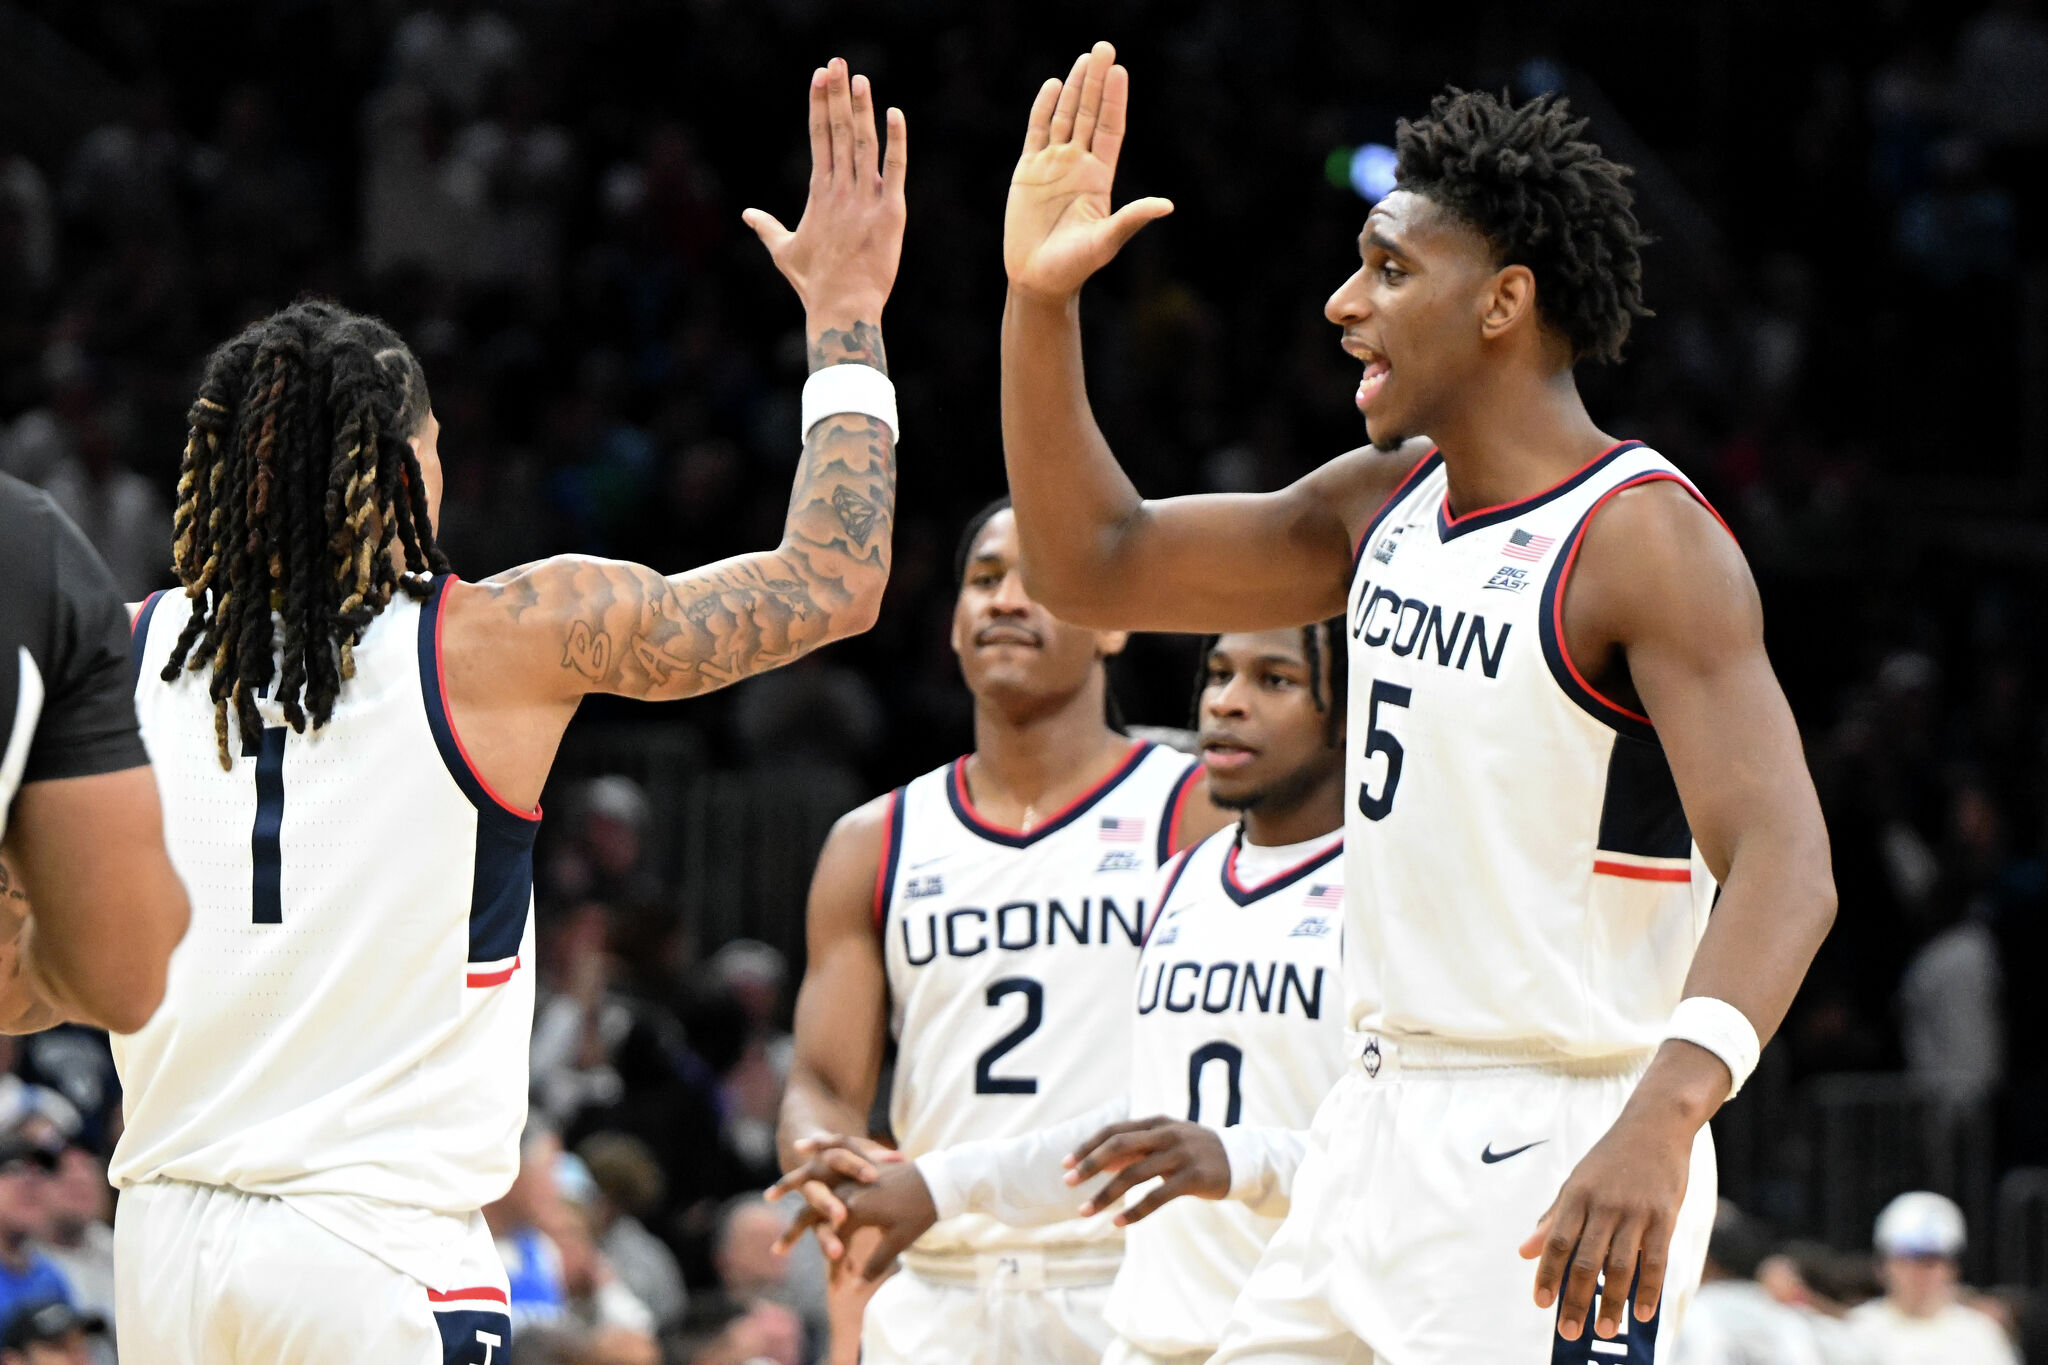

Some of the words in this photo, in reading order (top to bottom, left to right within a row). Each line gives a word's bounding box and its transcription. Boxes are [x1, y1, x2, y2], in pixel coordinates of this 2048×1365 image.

[1487, 575, 1531, 591] EAST
[1497, 566, 1528, 579] BIG
[1353, 580, 1512, 679] UCONN
[1359, 678, 1413, 821] 5
[241, 726, 288, 924] 1
[902, 897, 1145, 966] UCONN
[1137, 961, 1324, 1020] UCONN
[975, 977, 1043, 1095] 2
[1188, 1040, 1243, 1128] 0
